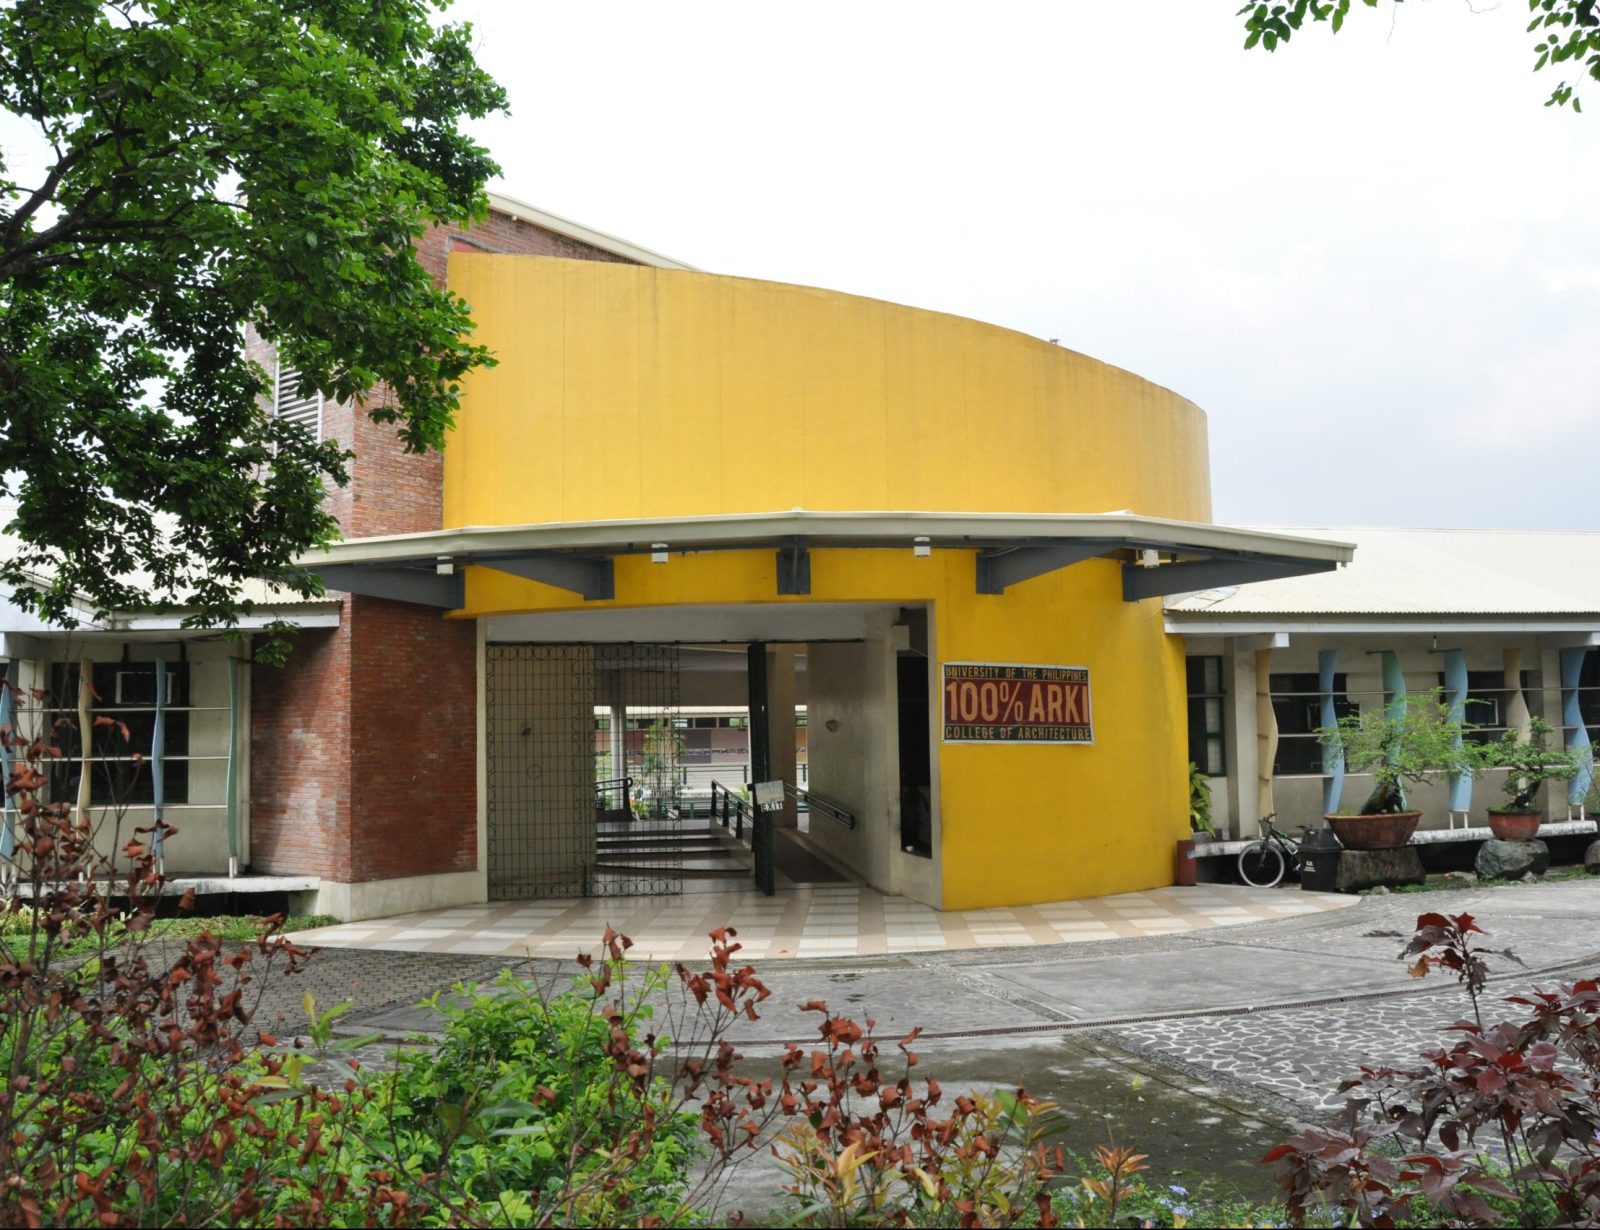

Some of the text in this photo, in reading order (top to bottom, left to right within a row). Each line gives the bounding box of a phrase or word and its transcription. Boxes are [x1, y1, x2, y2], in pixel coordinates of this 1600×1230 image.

[946, 666, 1087, 681] UNIVERSITY OF THE PHILIPPINES
[946, 681, 1090, 723] 100% ARKI
[946, 726, 1091, 740] COLLEGE OF ARCHITECTURE
[761, 801, 783, 812] EXIT
